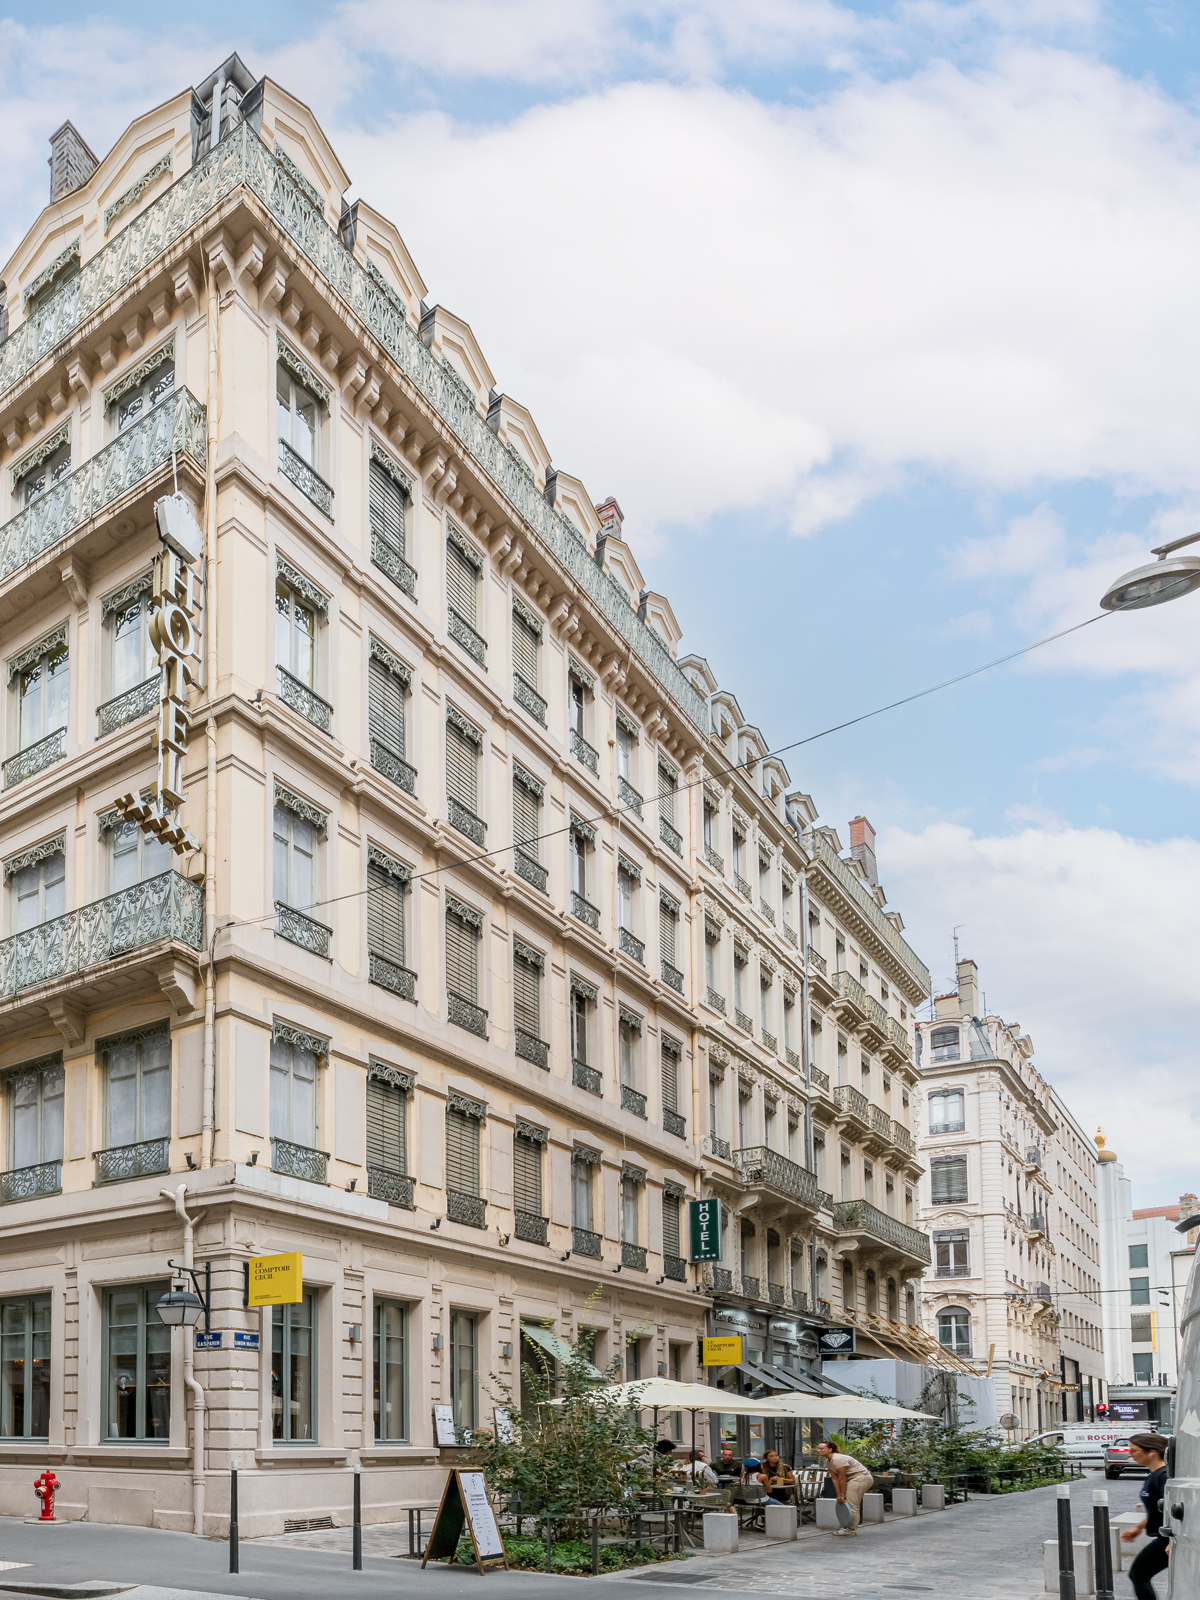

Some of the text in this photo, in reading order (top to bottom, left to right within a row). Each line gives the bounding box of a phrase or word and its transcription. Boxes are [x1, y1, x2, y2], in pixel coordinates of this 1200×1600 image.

[157, 548, 195, 805] HOTEL
[699, 1203, 710, 1251] HOTEL
[255, 1265, 290, 1274] COMPTOIR
